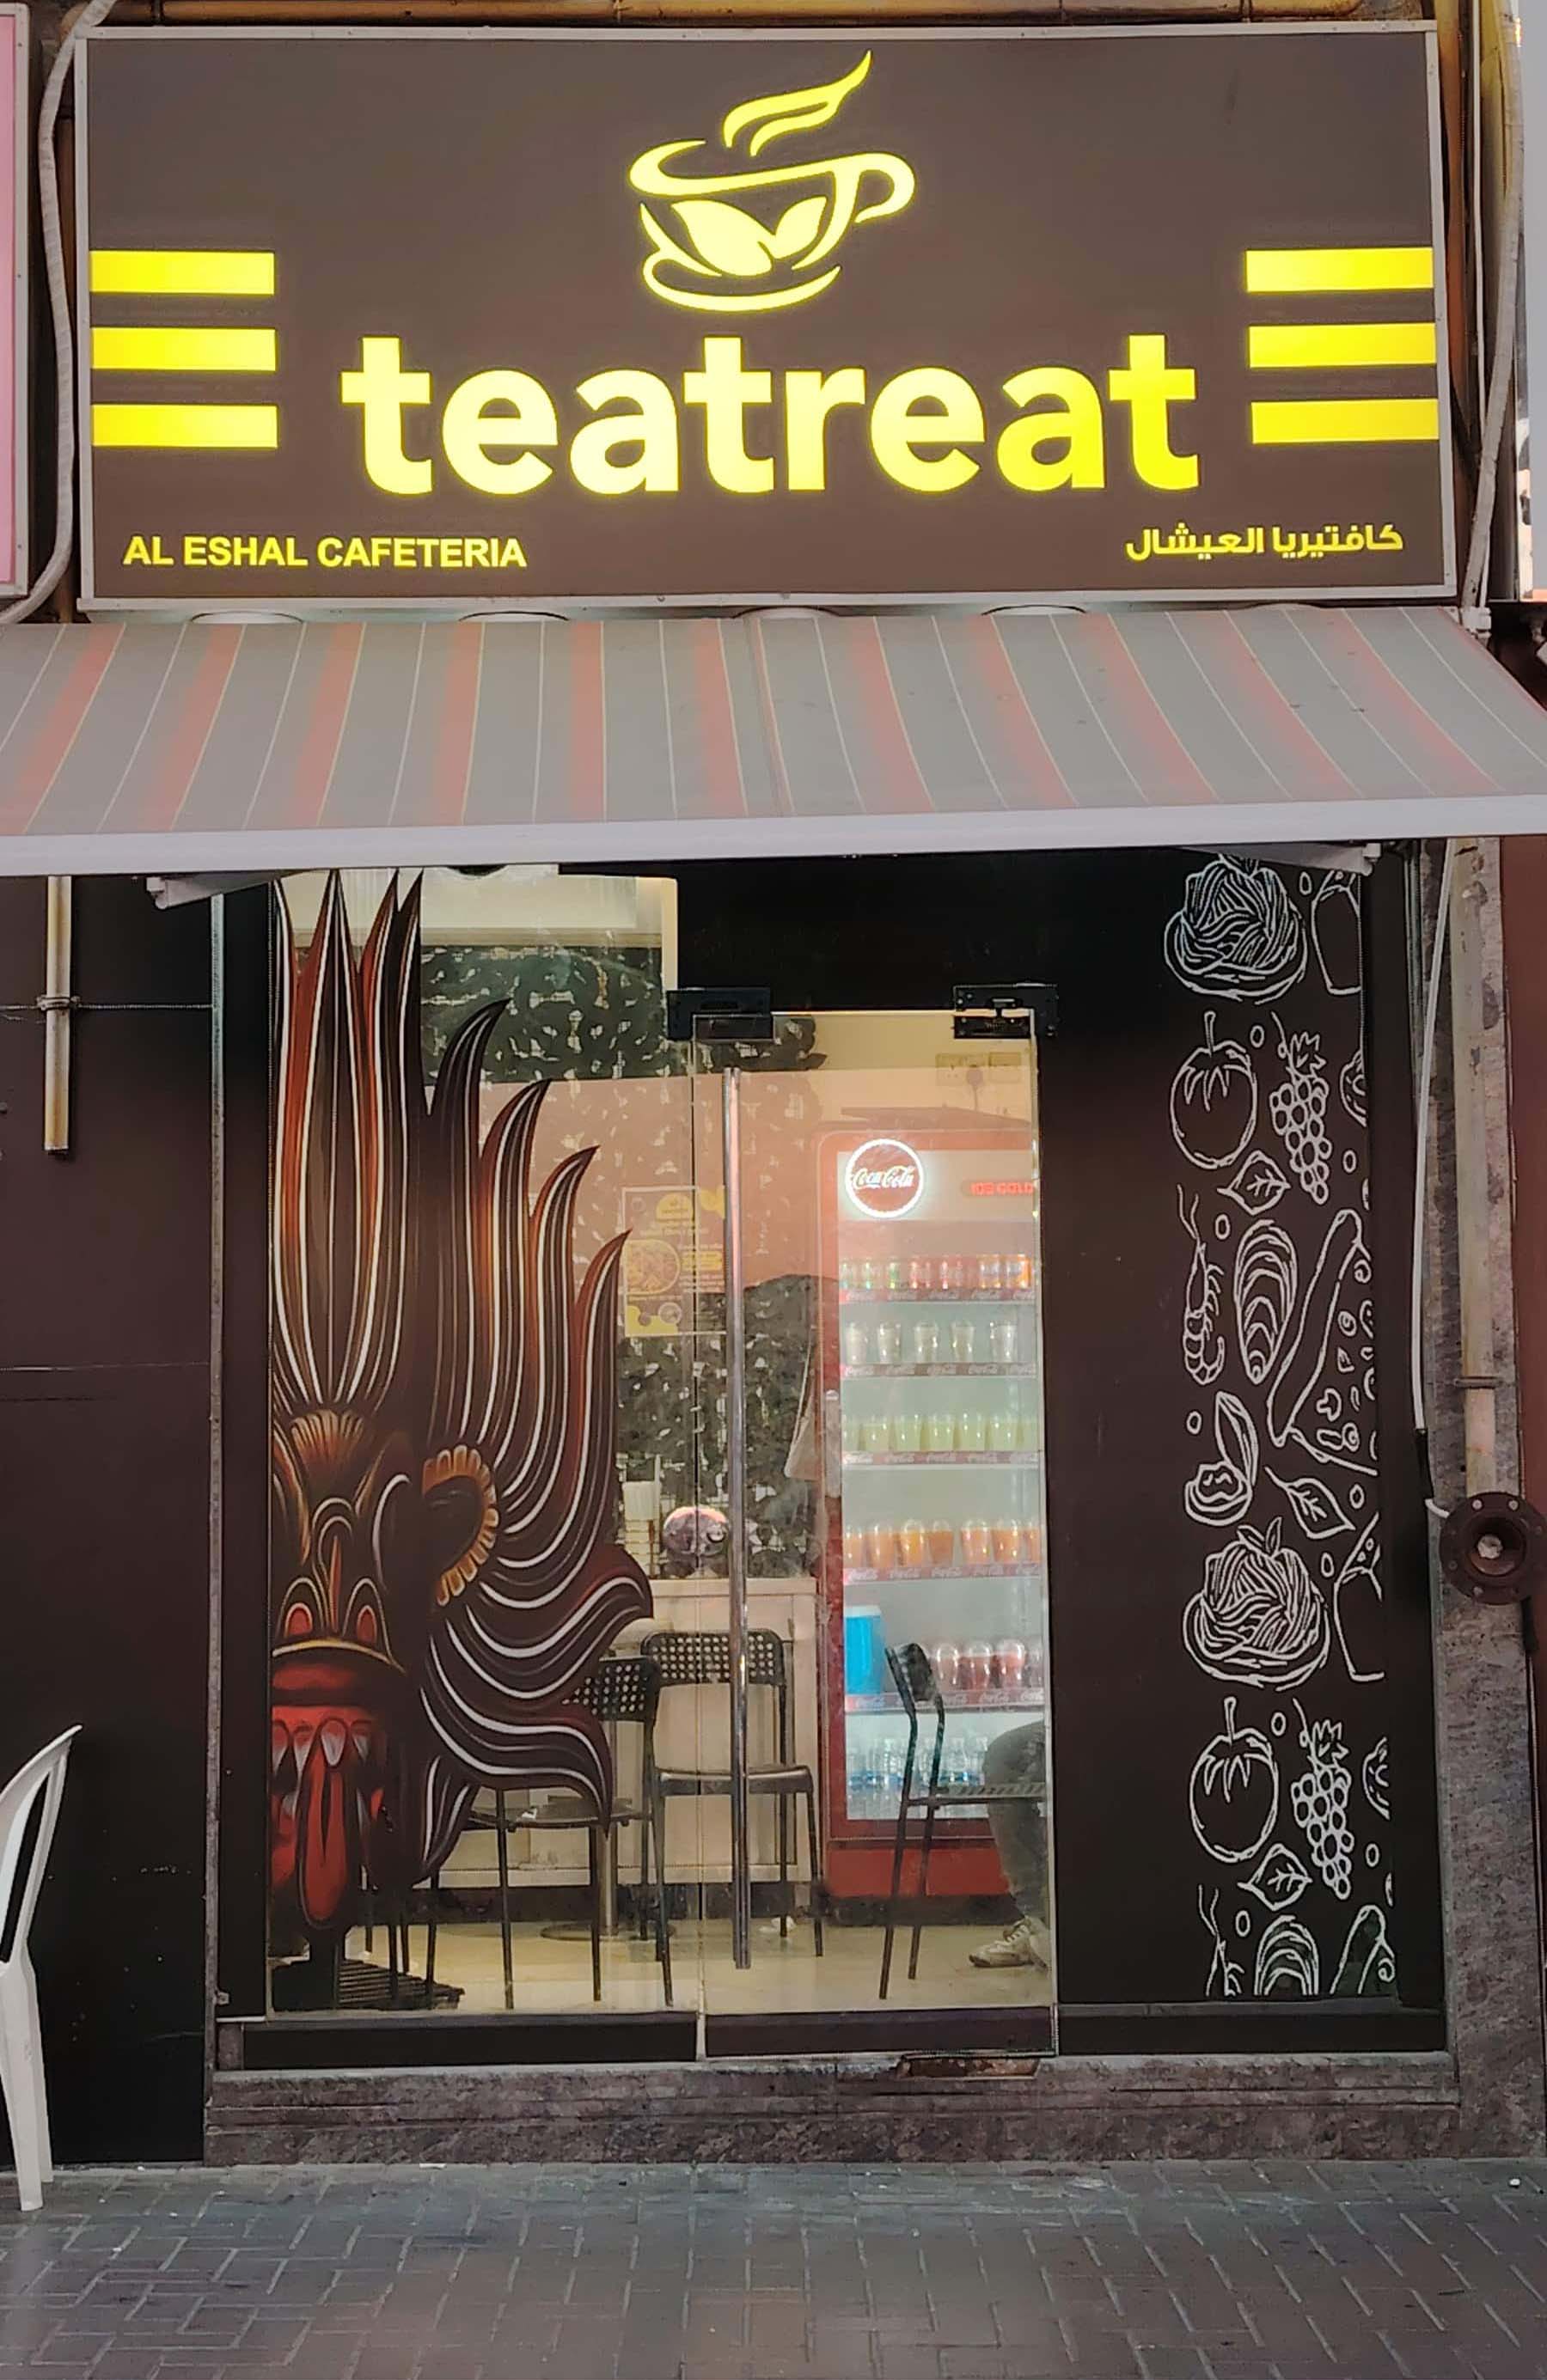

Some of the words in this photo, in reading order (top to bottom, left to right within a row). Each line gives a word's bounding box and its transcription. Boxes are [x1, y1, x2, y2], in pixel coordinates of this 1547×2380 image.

[340, 333, 1200, 496] teatreat
[122, 534, 174, 565] AL
[183, 535, 309, 567] ESHAL
[316, 536, 528, 569] CAFETERIA
[1125, 522, 1264, 561] العيشال
[1271, 522, 1404, 559] كافتيريا
